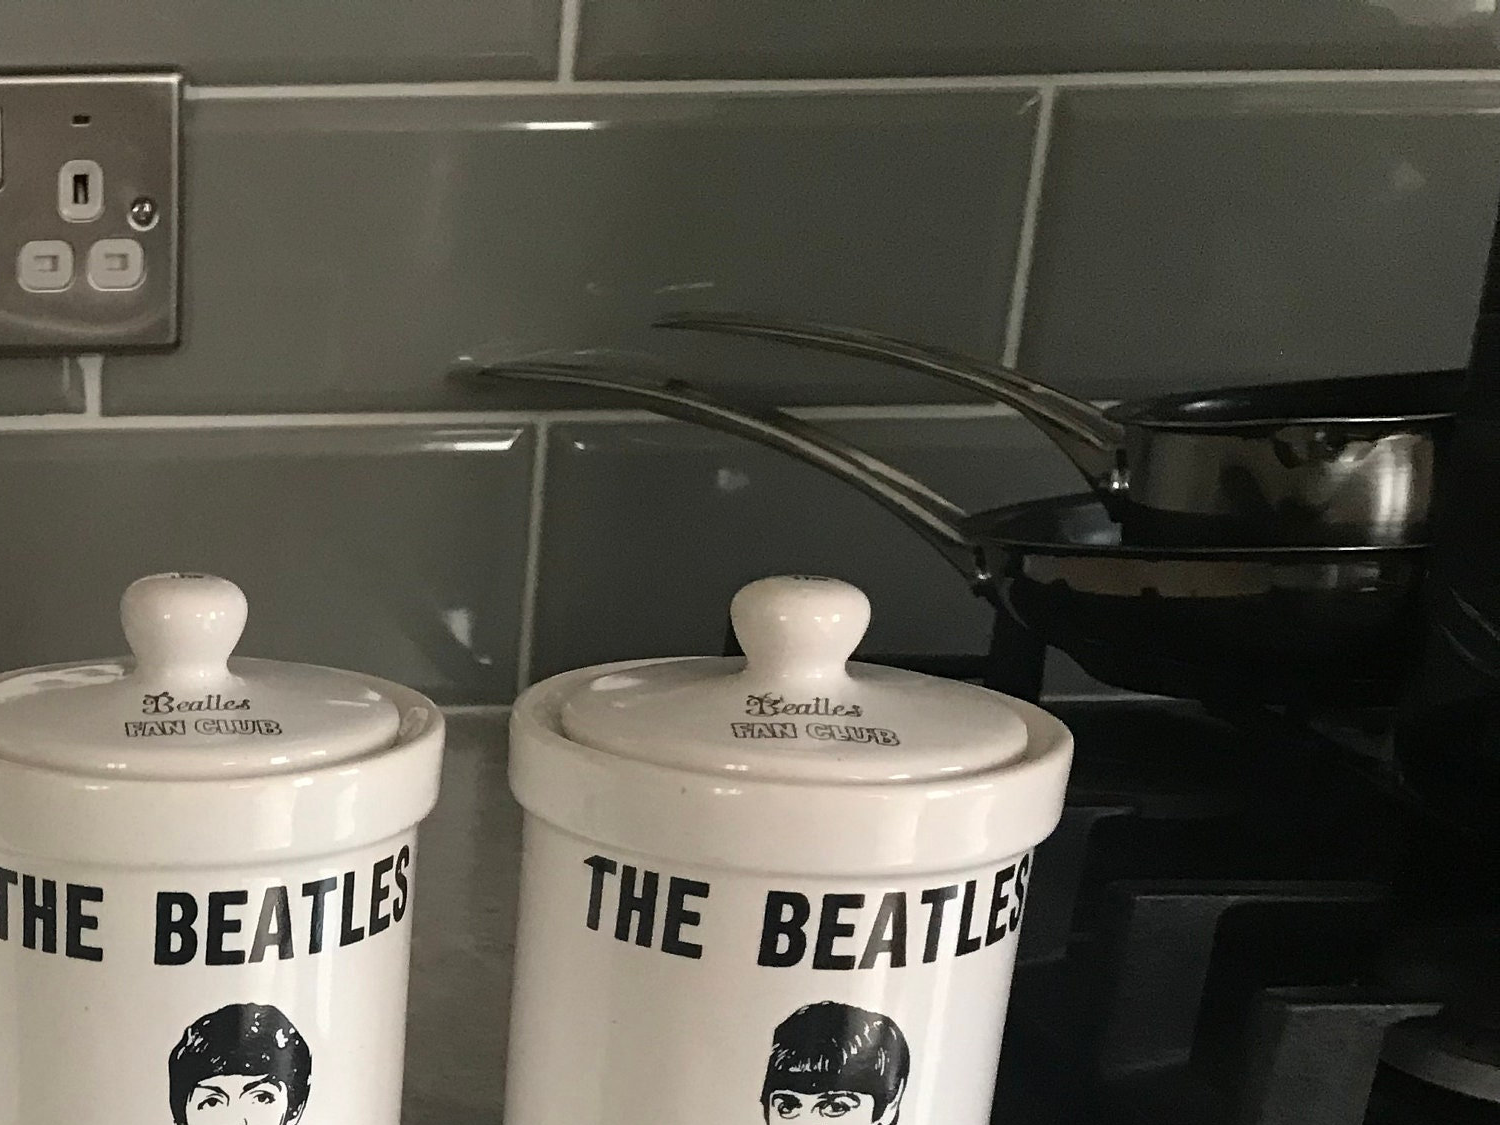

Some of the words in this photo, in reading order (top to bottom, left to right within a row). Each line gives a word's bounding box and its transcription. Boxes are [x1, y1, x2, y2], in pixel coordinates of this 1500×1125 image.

[141, 691, 251, 715] Beatles
[745, 692, 864, 718] Beatles
[124, 719, 187, 738] FAN
[194, 718, 283, 736] CLUB
[730, 722, 798, 739] FAN
[805, 722, 901, 747] CLUB
[153, 844, 411, 967] BEATLES
[583, 854, 710, 960] THE
[756, 852, 1030, 971] BEATLES
